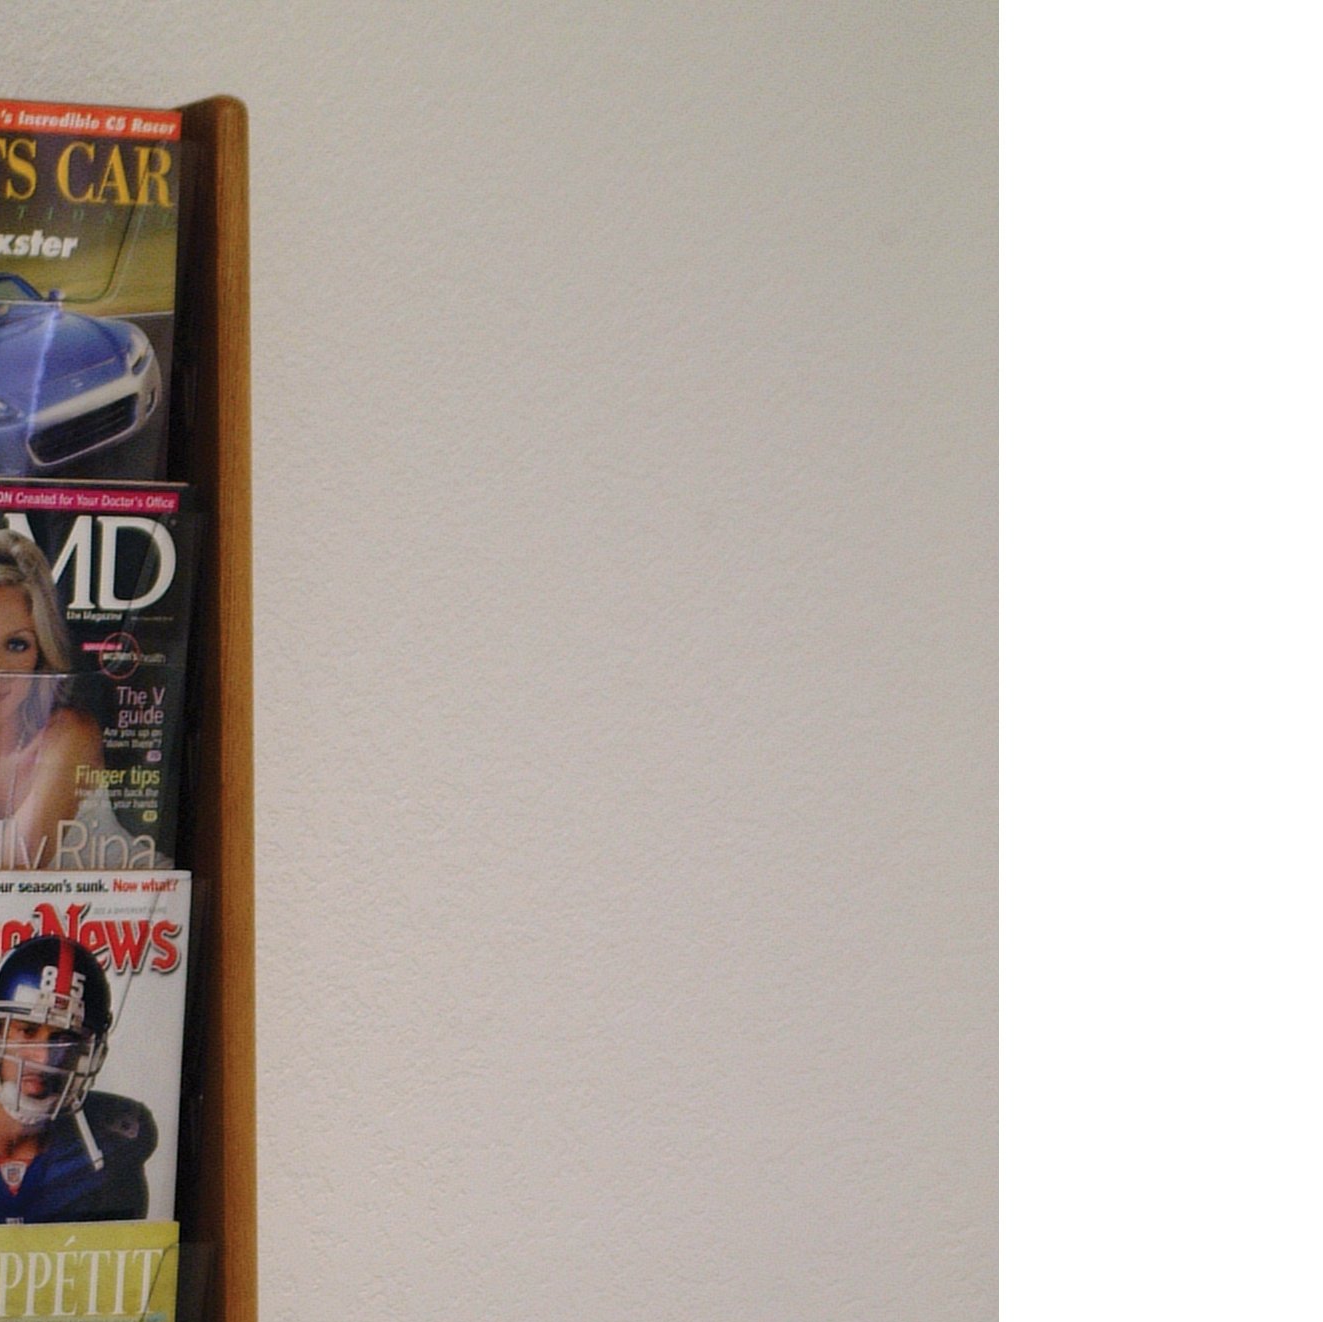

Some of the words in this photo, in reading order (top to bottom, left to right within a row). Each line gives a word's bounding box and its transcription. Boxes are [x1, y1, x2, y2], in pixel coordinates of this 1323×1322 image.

[18, 110, 100, 130] Incredible
[131, 117, 176, 135] Racer
[56, 140, 176, 208] CAR
[15, 491, 57, 505] Created
[59, 492, 73, 505] for
[77, 493, 98, 506] Your
[101, 494, 143, 508] Doctor's
[145, 495, 175, 509] Office
[116, 686, 148, 705] The
[152, 686, 166, 706] V
[118, 705, 164, 729] guide
[76, 765, 127, 789] Finger
[130, 765, 160, 789] tips
[18, 878, 72, 893] season's
[76, 878, 109, 893] sunk.
[113, 878, 138, 893] Now
[141, 878, 180, 892] what?
